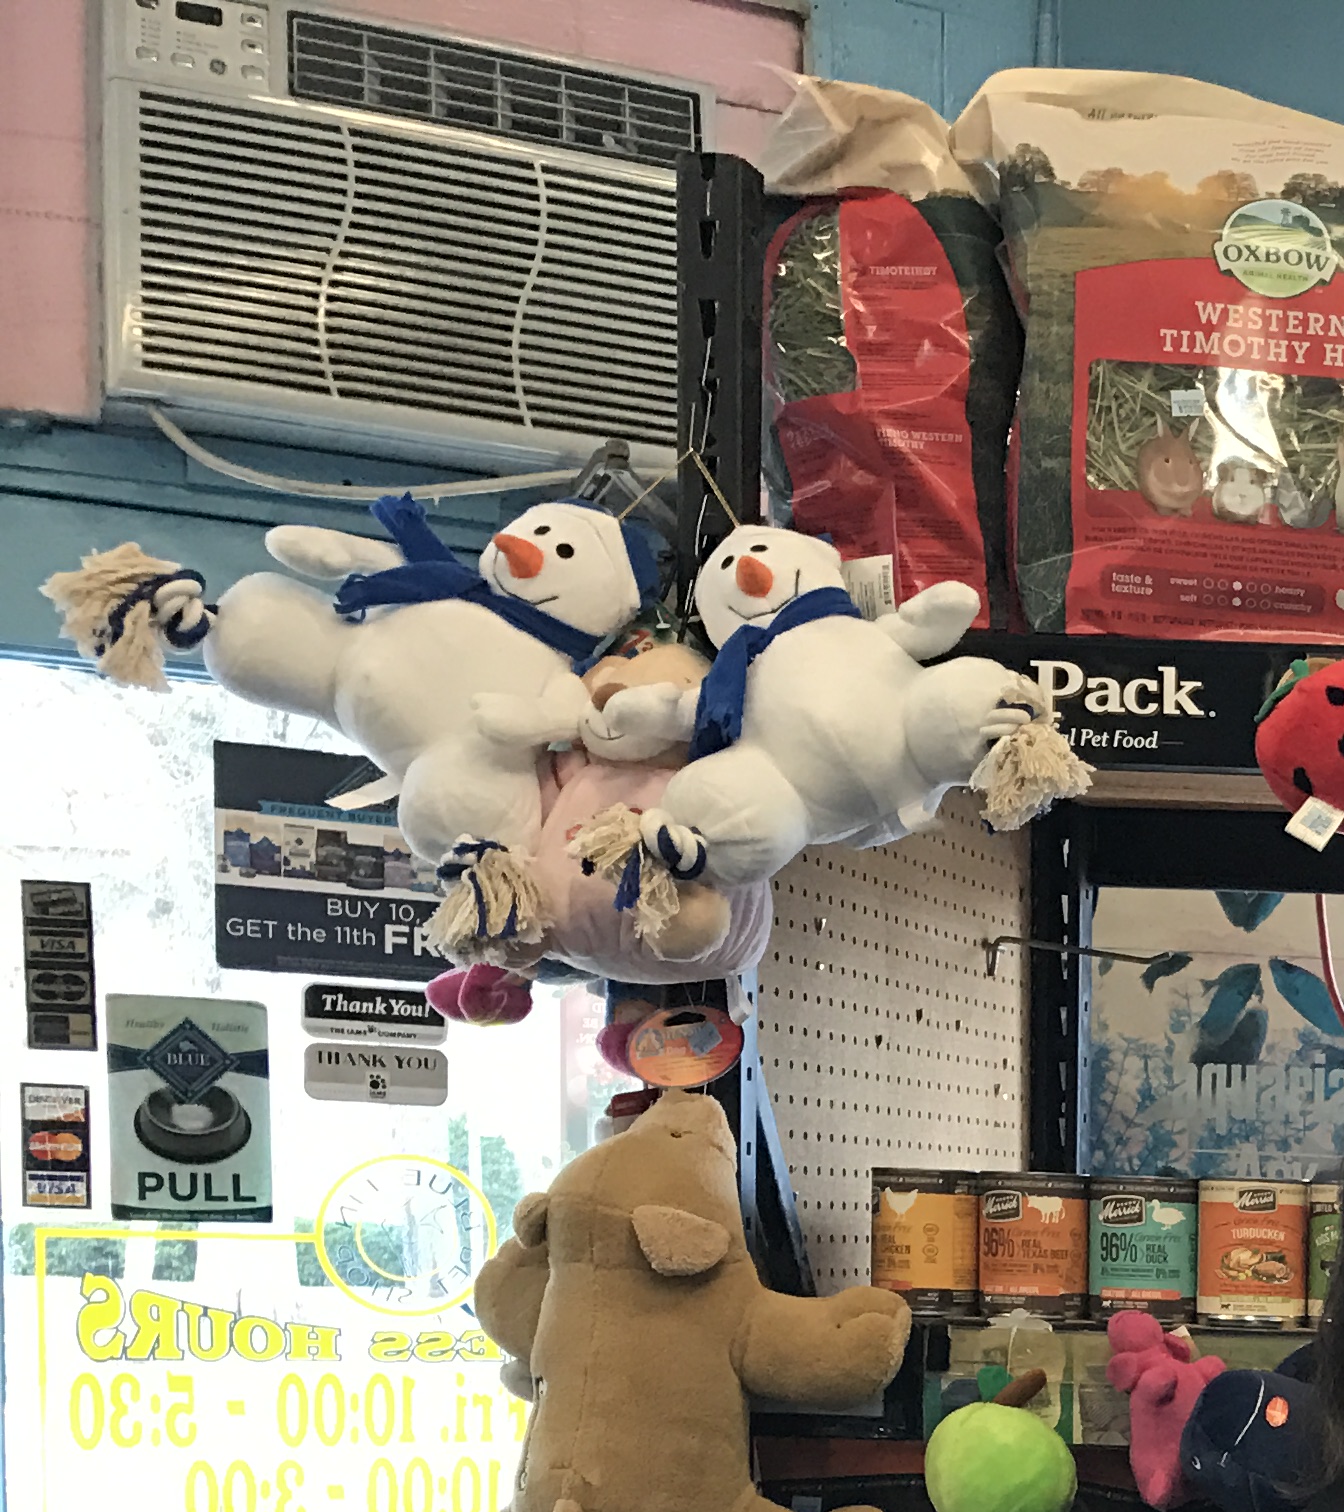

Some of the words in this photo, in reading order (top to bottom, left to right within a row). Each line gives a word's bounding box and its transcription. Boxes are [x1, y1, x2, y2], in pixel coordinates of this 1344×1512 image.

[1222, 244, 1331, 273] OXBOW
[1160, 328, 1310, 364] TIMOTHY
[1080, 729, 1108, 748] Pet
[1113, 730, 1159, 749] Food
[326, 898, 380, 919] BUY
[226, 918, 277, 939] GET
[287, 922, 327, 943] the
[334, 926, 376, 946] 11th
[322, 993, 387, 1015] Thank
[388, 998, 431, 1018] You!
[167, 1053, 210, 1066] BLUE
[318, 1050, 387, 1068] THANK
[394, 1055, 437, 1070] YOU
[137, 1171, 257, 1202] PULL
[1230, 1228, 1285, 1242] TURDUCKEN
[1145, 1253, 1169, 1264] DUCK
